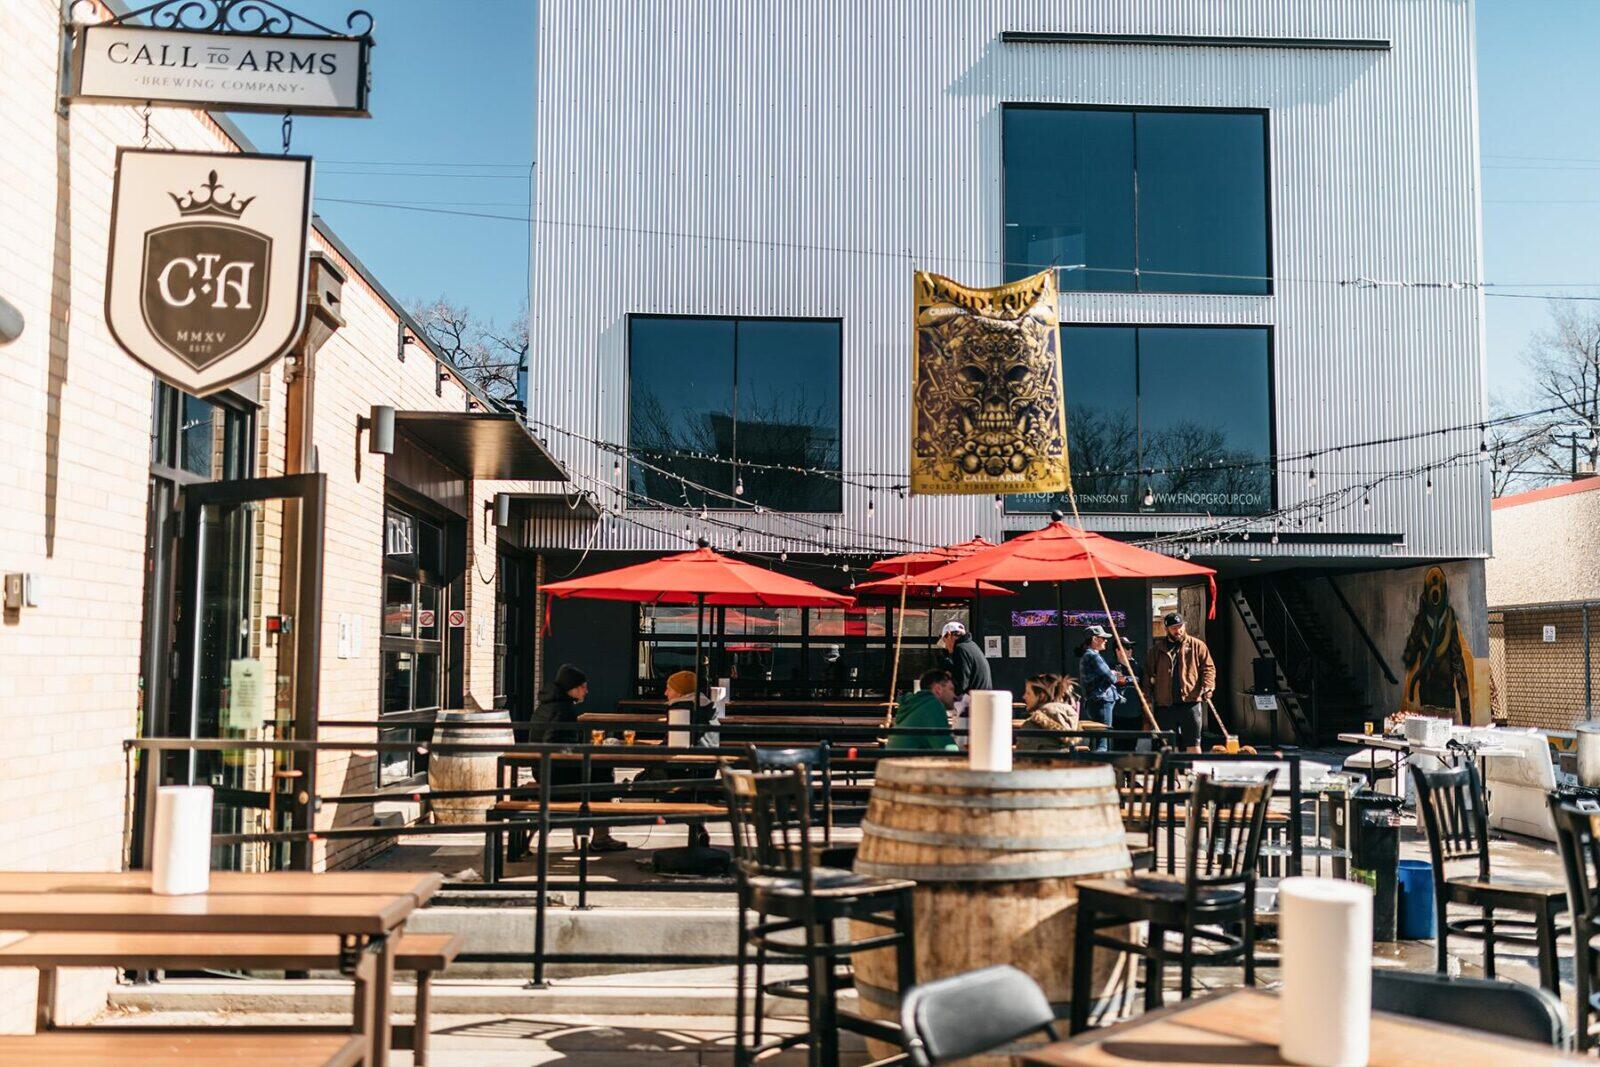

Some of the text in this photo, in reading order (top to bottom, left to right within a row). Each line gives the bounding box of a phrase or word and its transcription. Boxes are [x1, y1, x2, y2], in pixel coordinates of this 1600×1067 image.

[107, 42, 338, 76] CALL TO ARMS
[141, 76, 299, 94] BREWING COMPANY
[176, 330, 226, 343] MMXV
[963, 474, 989, 482] CALL
[999, 473, 1026, 482] ARMS
[1079, 494, 1119, 504] TENNYSON
[1120, 494, 1129, 504] ST
